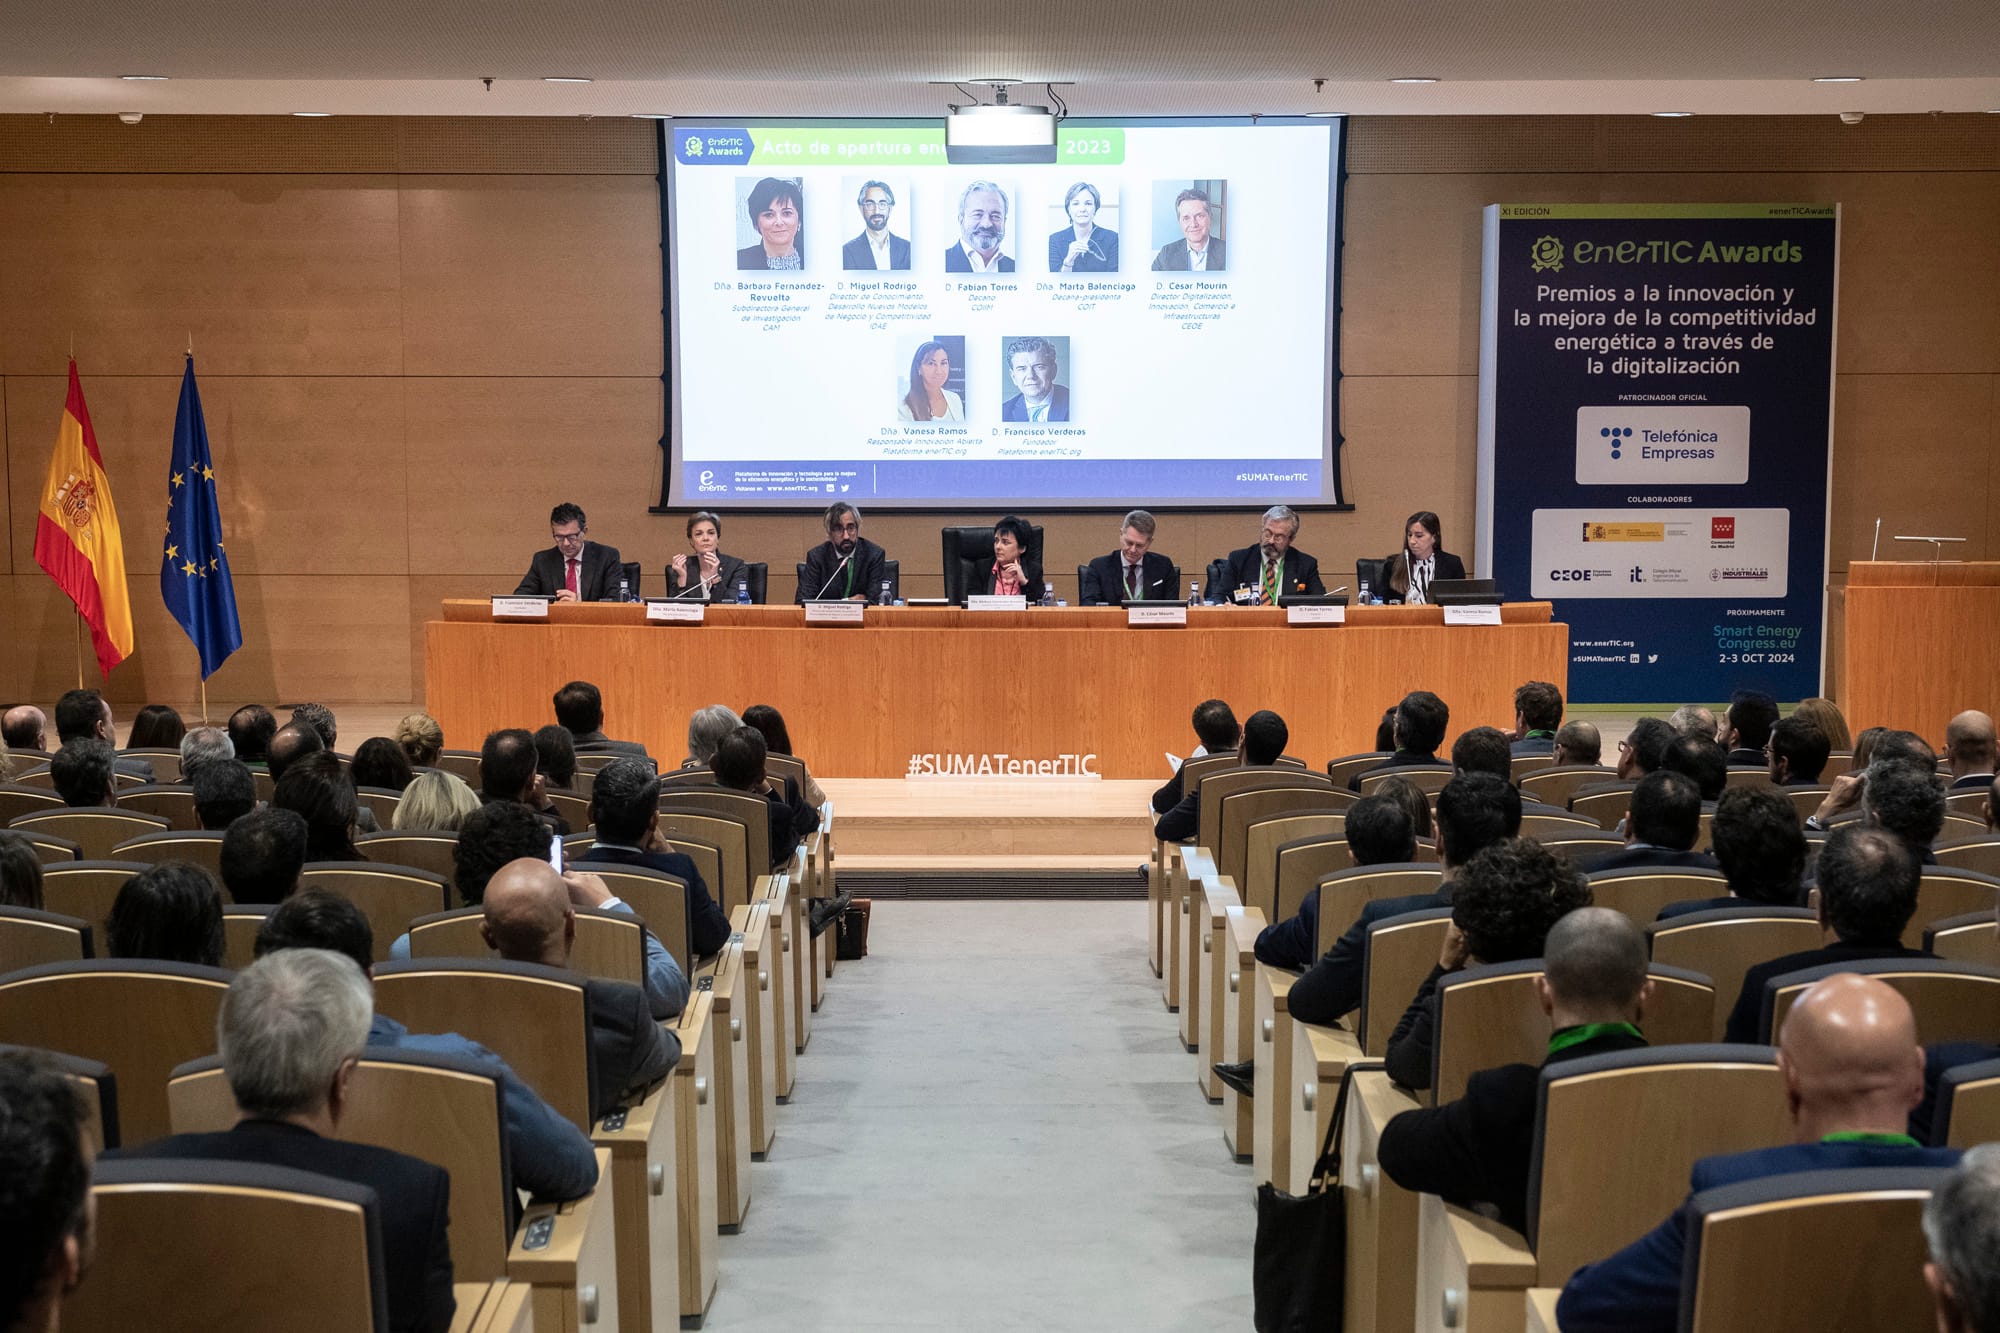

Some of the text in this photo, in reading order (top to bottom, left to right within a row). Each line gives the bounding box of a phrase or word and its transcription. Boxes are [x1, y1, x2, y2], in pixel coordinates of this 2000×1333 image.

[708, 138, 743, 146] enerTIC
[708, 147, 743, 156] Awards
[762, 140, 802, 155] Acto
[809, 140, 831, 155] de
[838, 142, 912, 158] apertura
[1065, 139, 1111, 155] 2023
[1573, 240, 1802, 264] enerTIC Awards
[850, 282, 880, 292] Miguel
[884, 282, 917, 292] Rodrigo
[1088, 283, 1136, 292] Balenciaga
[1538, 284, 1794, 306] Premios a la innovación y
[1514, 308, 1816, 330] la mejora de la competitividad
[1554, 333, 1774, 354] energética a través de
[1587, 356, 1740, 378] la digitalización
[1618, 394, 1708, 402] PATROCINADOR OFICIAL
[904, 428, 935, 436] Vanesa
[939, 428, 968, 436] Ramos
[1004, 428, 1045, 436] Francisco
[1048, 428, 1086, 436] Verderas
[1642, 429, 1718, 443] Telefónica
[1022, 438, 1057, 446] Fundador
[882, 448, 923, 456] Plataforma
[998, 448, 1038, 456] Plataforma
[1642, 446, 1715, 462] Empresas
[1236, 473, 1308, 481] #SUMATenerTIC
[1550, 570, 1591, 581] CEOE
[1714, 625, 1752, 636] Smart
[1573, 640, 1634, 648] www.enerTIC.org
[1718, 638, 1796, 650] Congress.eu
[1573, 655, 1626, 663] #SUMATenerTIC
[1719, 654, 1795, 663] 2-3 OCT 2024
[908, 754, 1097, 776] #SUMATenerTIC
